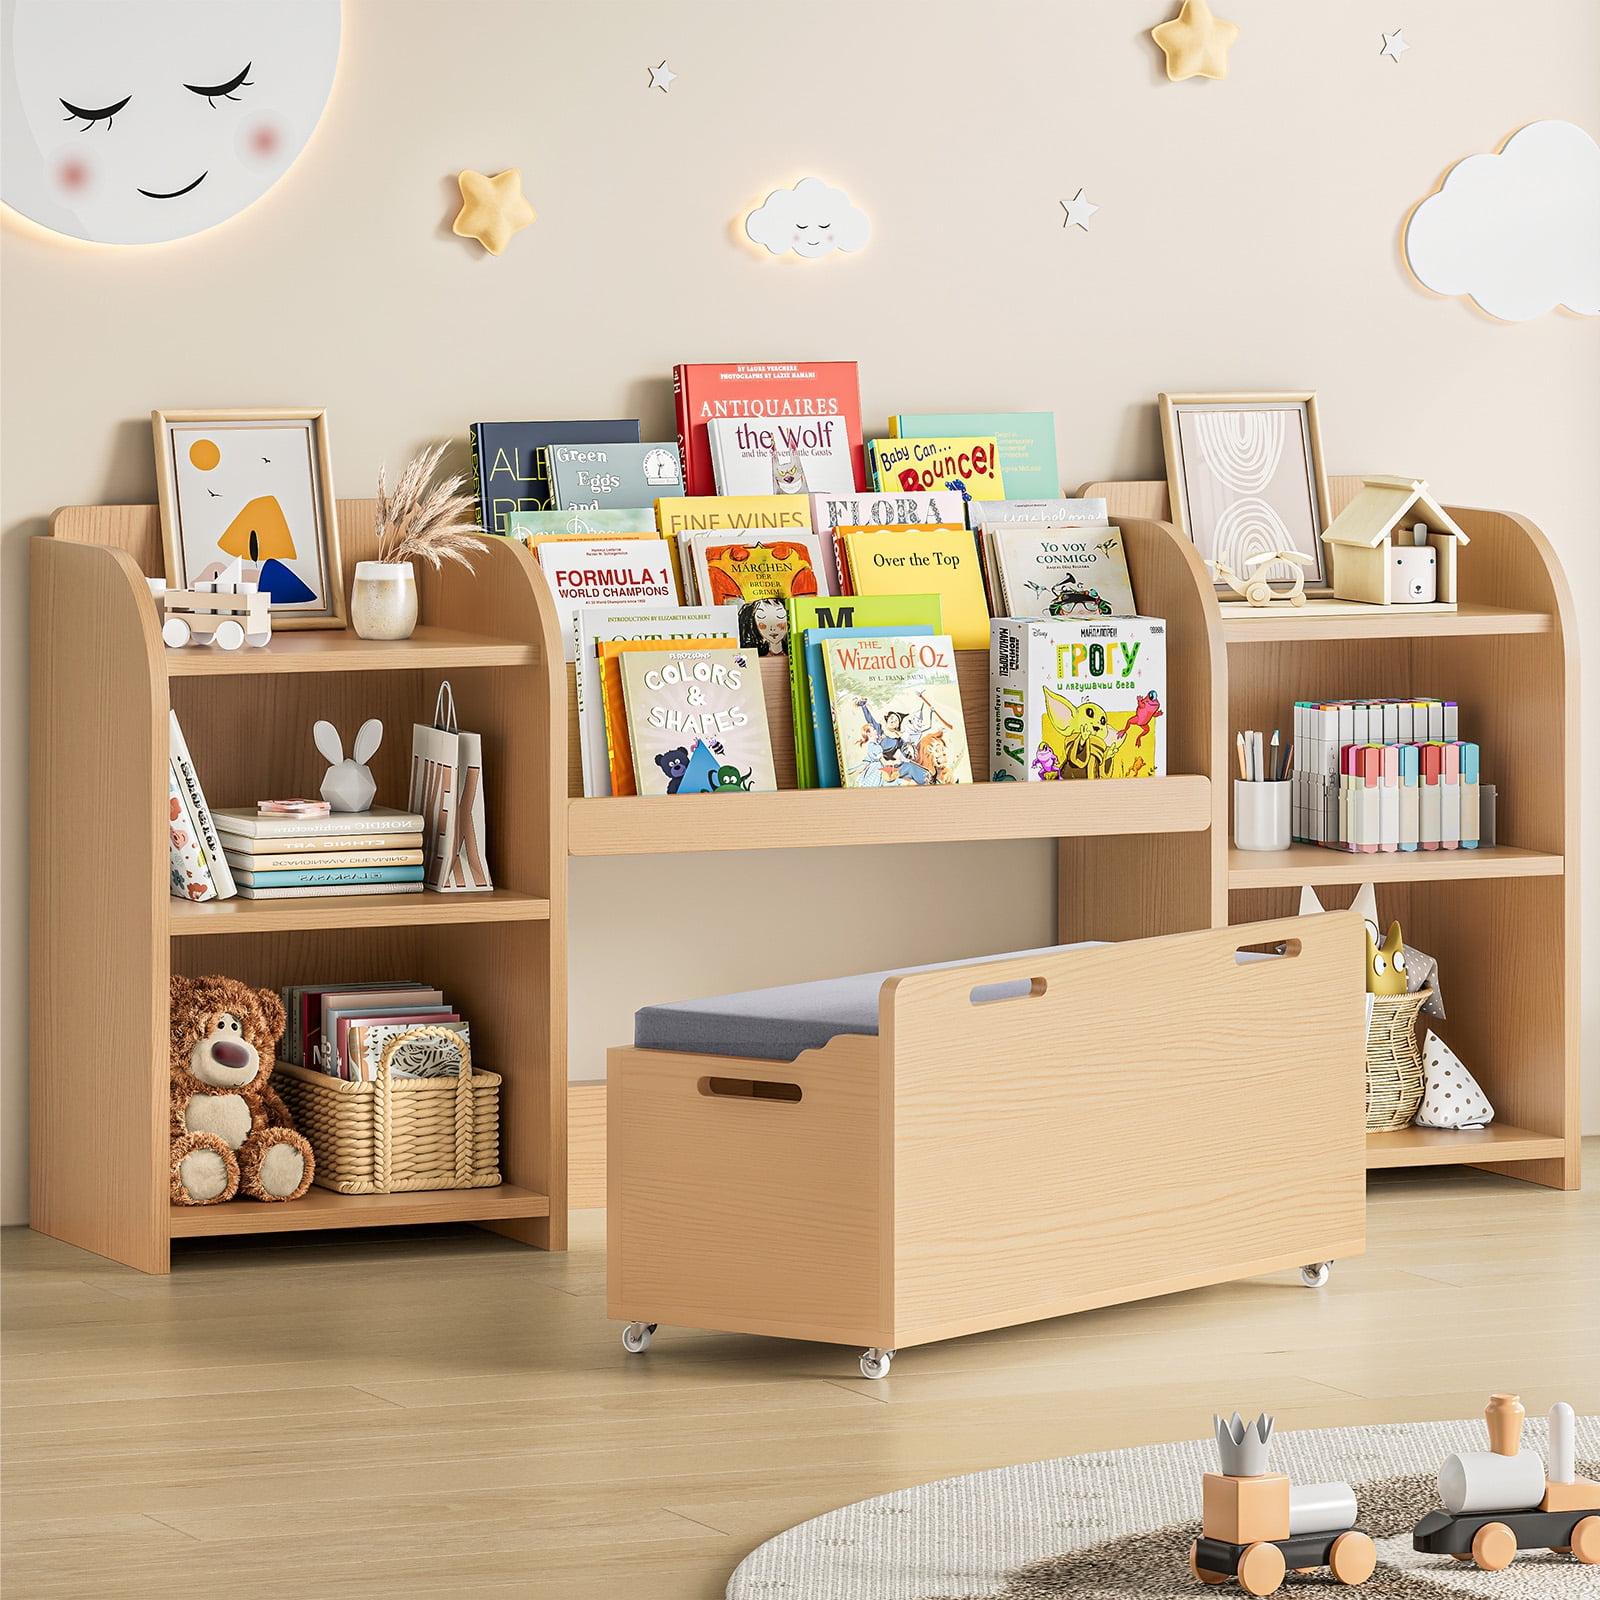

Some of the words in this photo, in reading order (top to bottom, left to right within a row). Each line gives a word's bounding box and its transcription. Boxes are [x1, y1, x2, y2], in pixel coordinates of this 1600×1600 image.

[701, 398, 838, 418] ANTIQUAIRES
[735, 422, 774, 450] the
[778, 420, 834, 449] Wolf
[556, 446, 608, 464] Green
[741, 449, 755, 458] and
[756, 449, 768, 457] the
[811, 447, 833, 457] Goats
[880, 446, 910, 472] Baby
[898, 442, 995, 491] Bounce!
[577, 470, 621, 494] Eggs
[567, 499, 600, 511] and
[826, 498, 944, 528] FLORA
[671, 514, 720, 533] FINE
[727, 511, 804, 529] WINES
[1062, 543, 1087, 552] VOY
[731, 562, 793, 573] MÄRCHEN
[873, 553, 906, 567] Over
[909, 552, 930, 566] the
[932, 551, 960, 569] Top
[1036, 553, 1097, 564] CONMIGO
[555, 568, 655, 587] FORMULA
[660, 568, 669, 585] 1
[558, 588, 600, 599] WORLD
[603, 586, 669, 598] CHAMPIONS
[1032, 628, 1048, 639] Disney
[858, 640, 882, 650] THE
[836, 646, 897, 671] Wizard
[899, 644, 916, 669] of
[919, 645, 949, 668] Oz
[1056, 641, 1141, 679] ГРОГУ
[644, 661, 742, 691] COLORS
[1065, 682, 1113, 692] лягушачьи
[1115, 680, 1136, 689] бега
[686, 685, 706, 706] &
[647, 705, 748, 735] SHAPES
[1003, 688, 1025, 767] ГРОГУ
